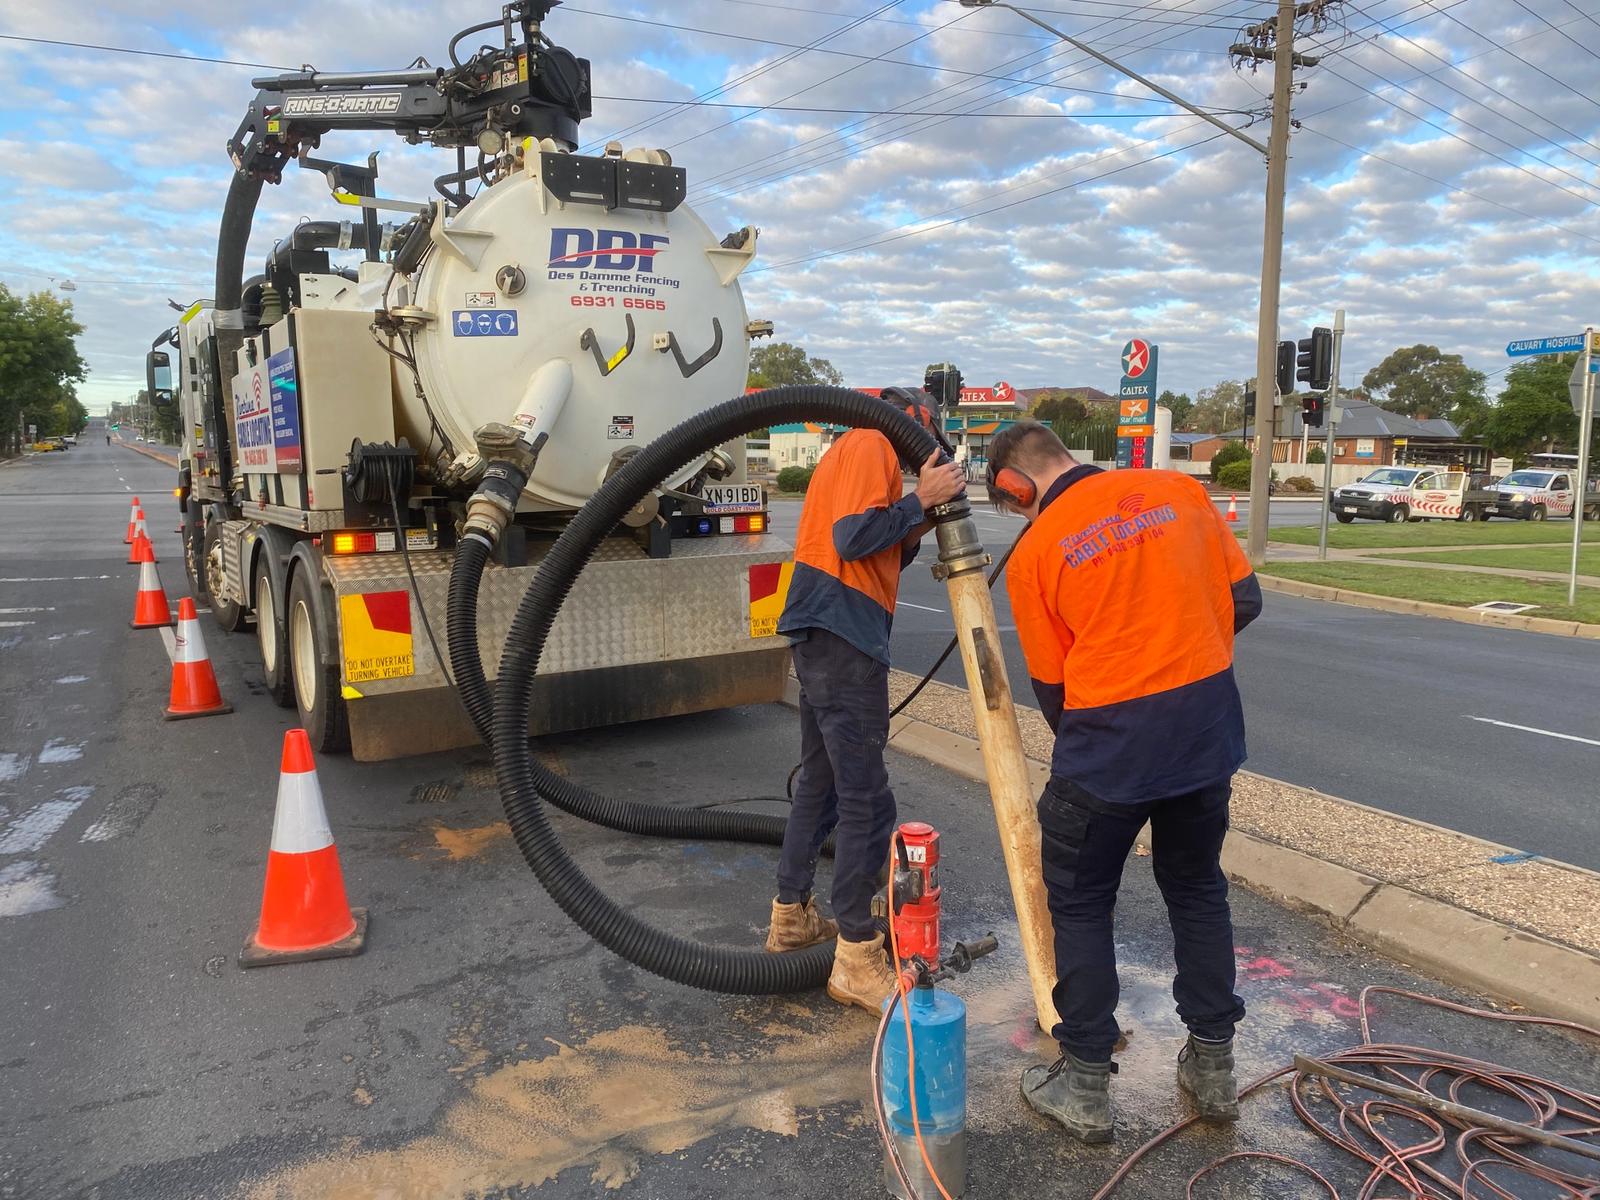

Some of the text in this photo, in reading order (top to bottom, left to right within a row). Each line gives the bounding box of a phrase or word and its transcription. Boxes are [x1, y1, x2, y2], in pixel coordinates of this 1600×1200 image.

[284, 95, 400, 114] RING-O-MATIC
[547, 228, 670, 272] DDF
[548, 271, 680, 288] Des Damme Fencing
[579, 282, 656, 296] & Trenching
[570, 296, 666, 311] 6931 6565
[1510, 335, 1583, 352] CALVARY HOSPITAL
[1121, 386, 1149, 395] CALTEX
[1065, 504, 1178, 569] CABLE LOCATING
[348, 655, 410, 671] DO NOT OVERTAKE
[350, 665, 411, 681] TURNING VEHICLE
